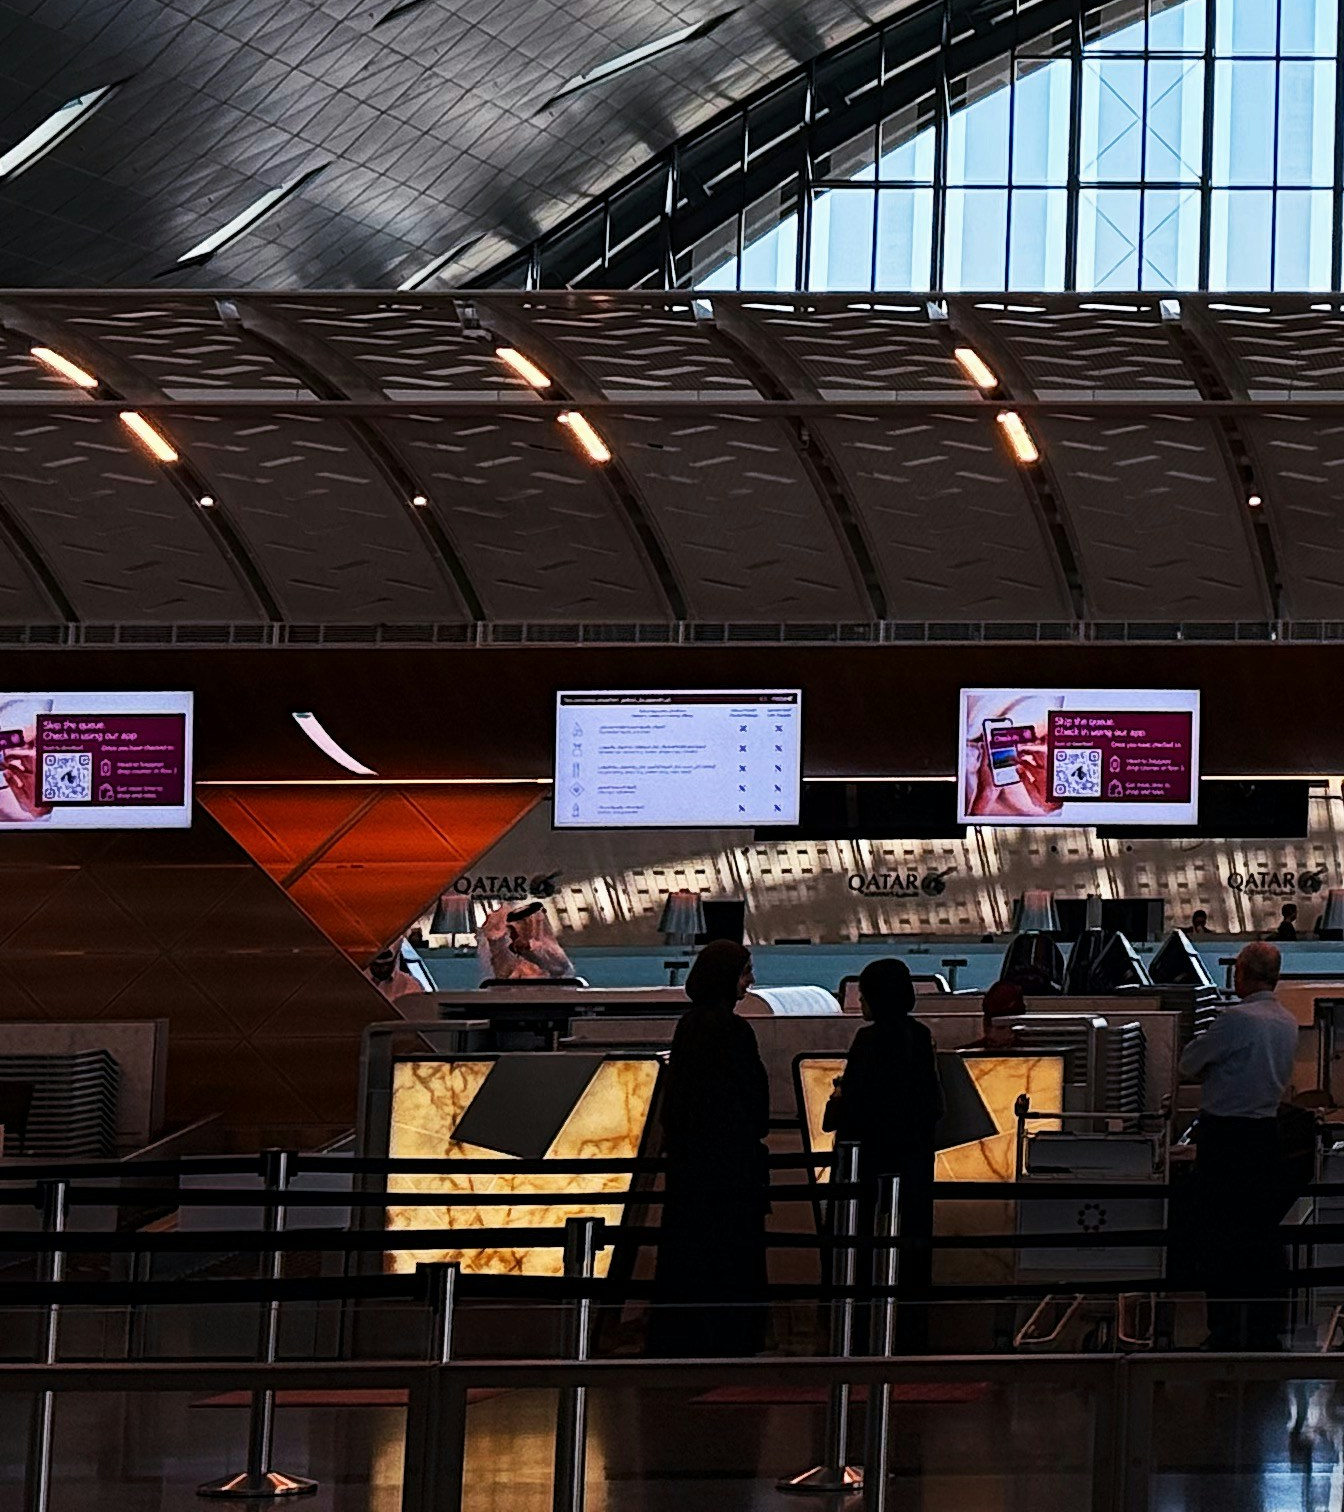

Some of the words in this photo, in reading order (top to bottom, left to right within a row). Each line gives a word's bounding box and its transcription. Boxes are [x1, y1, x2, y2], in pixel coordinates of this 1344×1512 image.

[43, 720, 62, 730] Skip
[63, 720, 77, 729] the
[1055, 717, 1073, 727] Skip
[1074, 717, 1087, 726] the
[43, 731, 69, 740] Check
[121, 733, 138, 741] app
[1055, 727, 1079, 736] Check
[1130, 729, 1146, 737] app
[453, 876, 527, 895] QATAR
[848, 873, 919, 894] QATAR
[1227, 872, 1295, 892] QATAR
